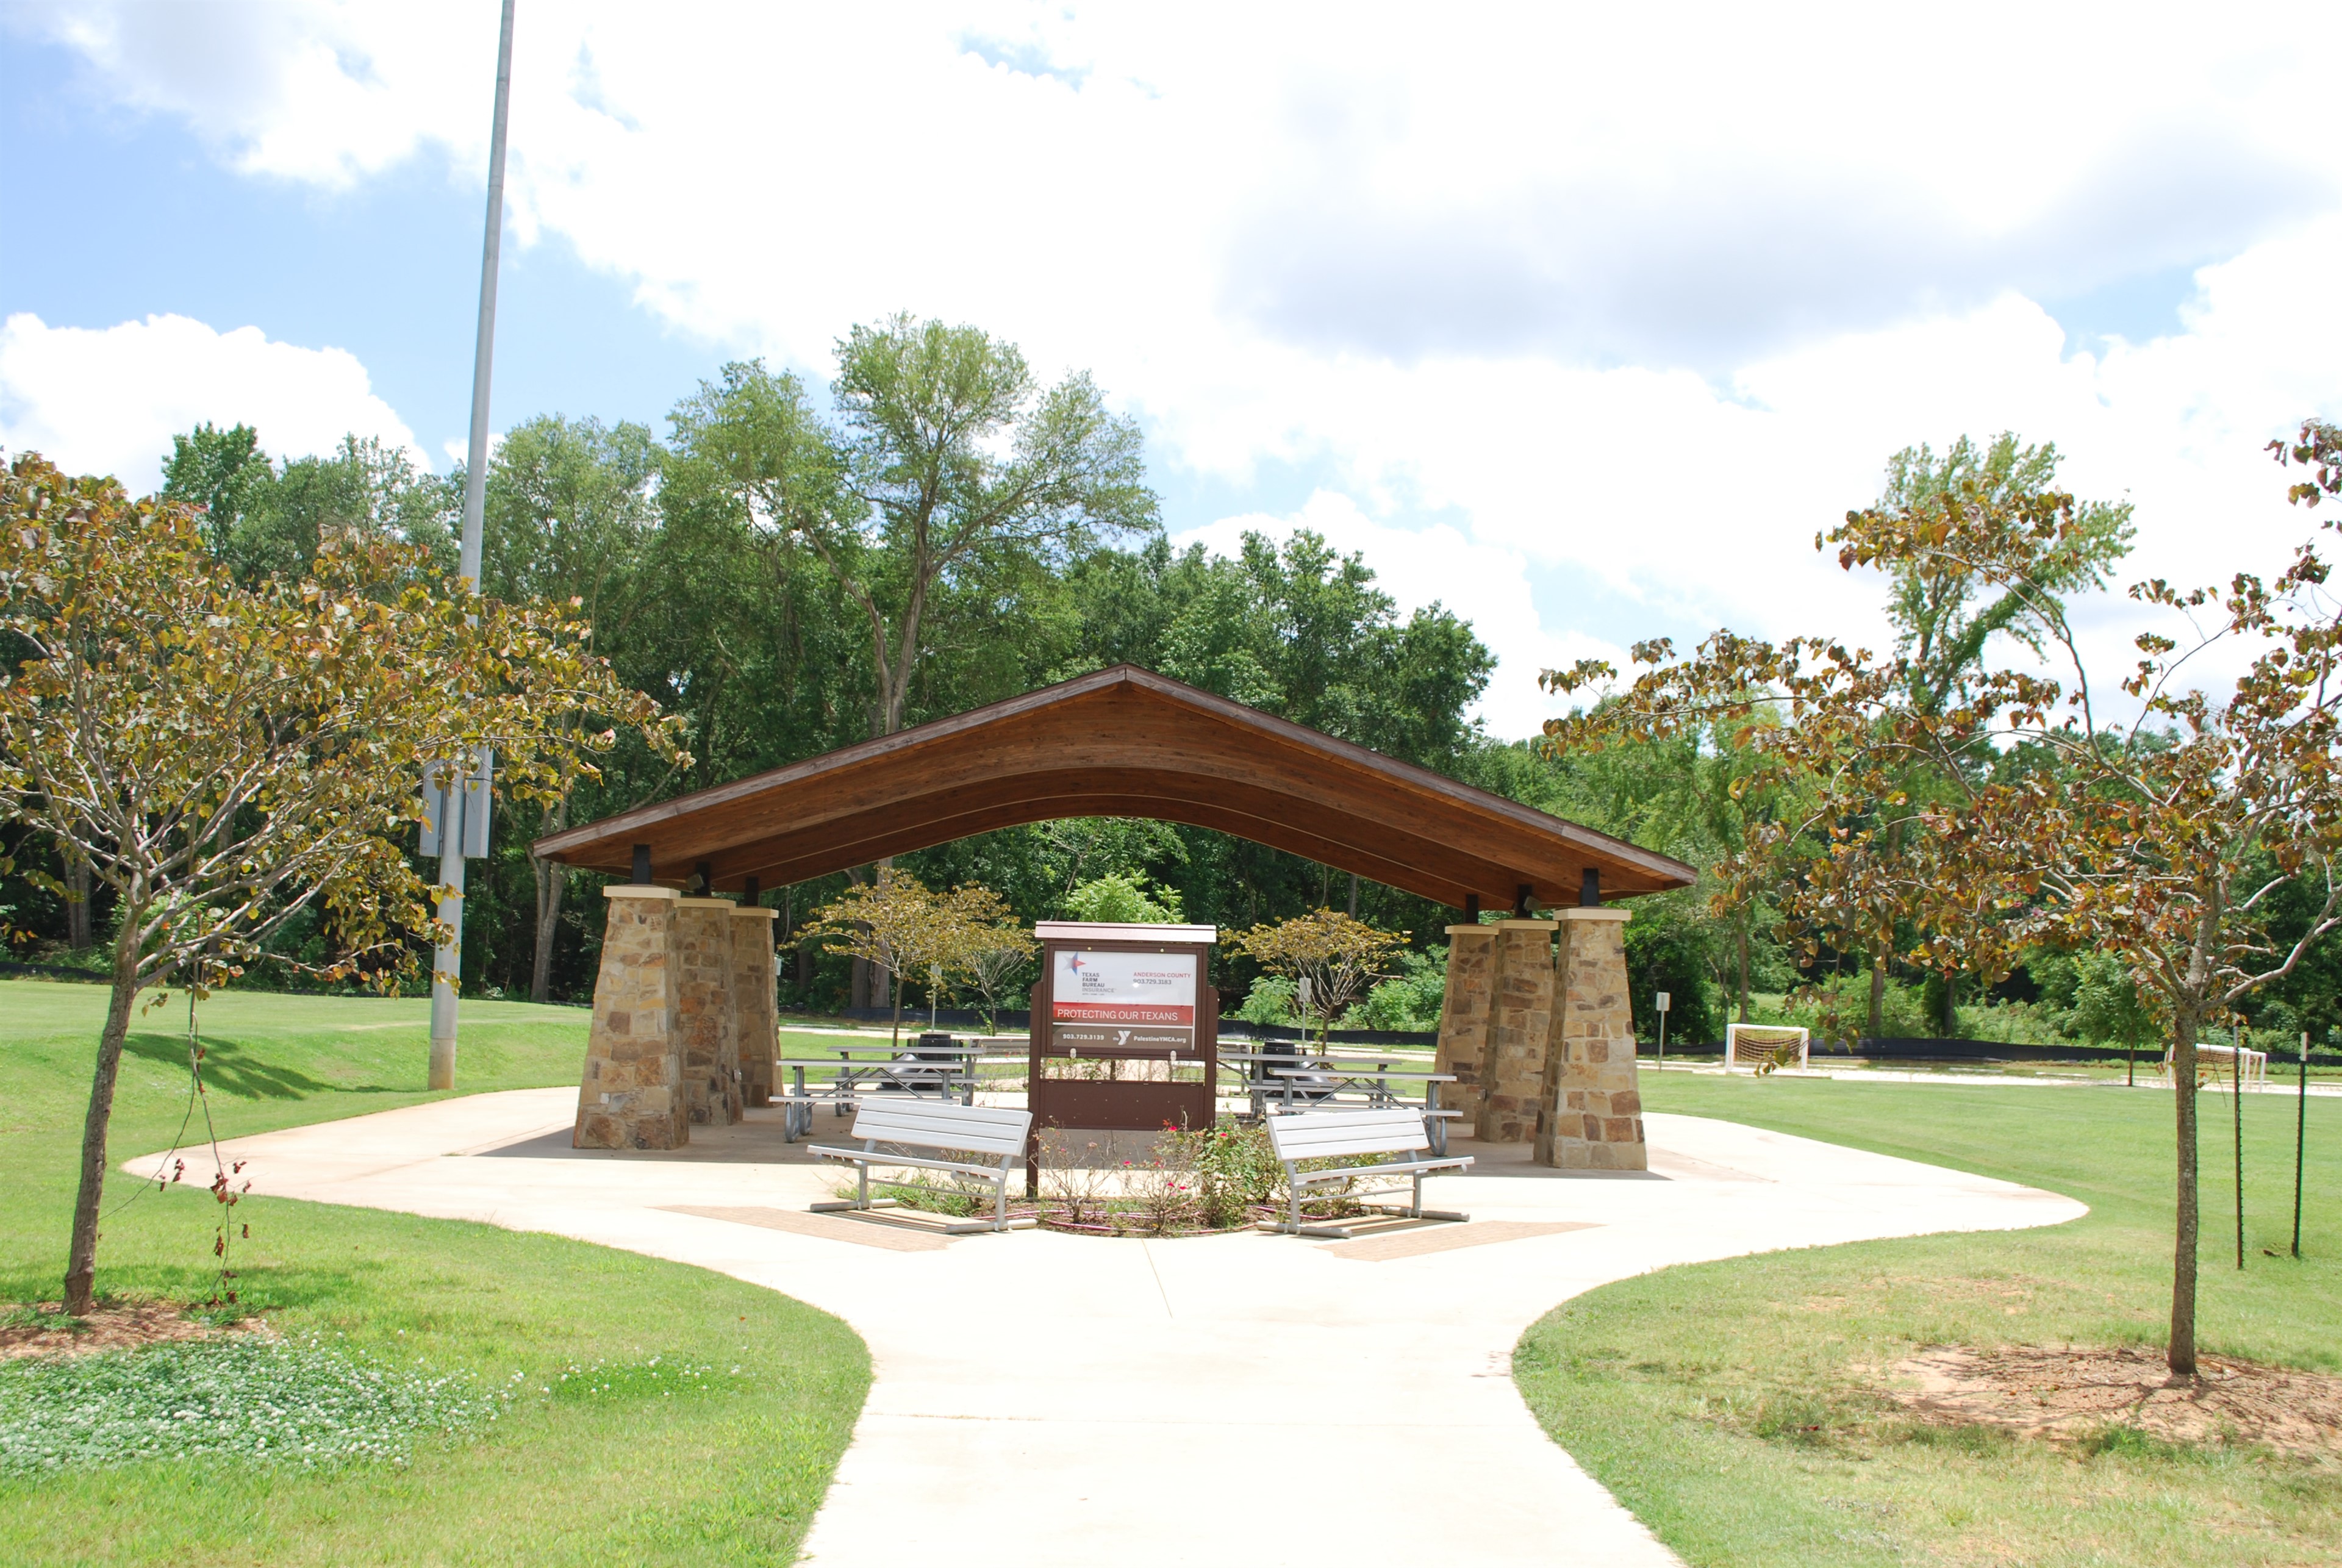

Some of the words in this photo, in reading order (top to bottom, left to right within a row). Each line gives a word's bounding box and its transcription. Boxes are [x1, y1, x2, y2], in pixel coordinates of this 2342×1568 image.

[1057, 1009, 1116, 1019] PROTECTING
[1118, 1011, 1139, 1020] OUR
[1141, 1011, 1178, 1021] TEXANS
